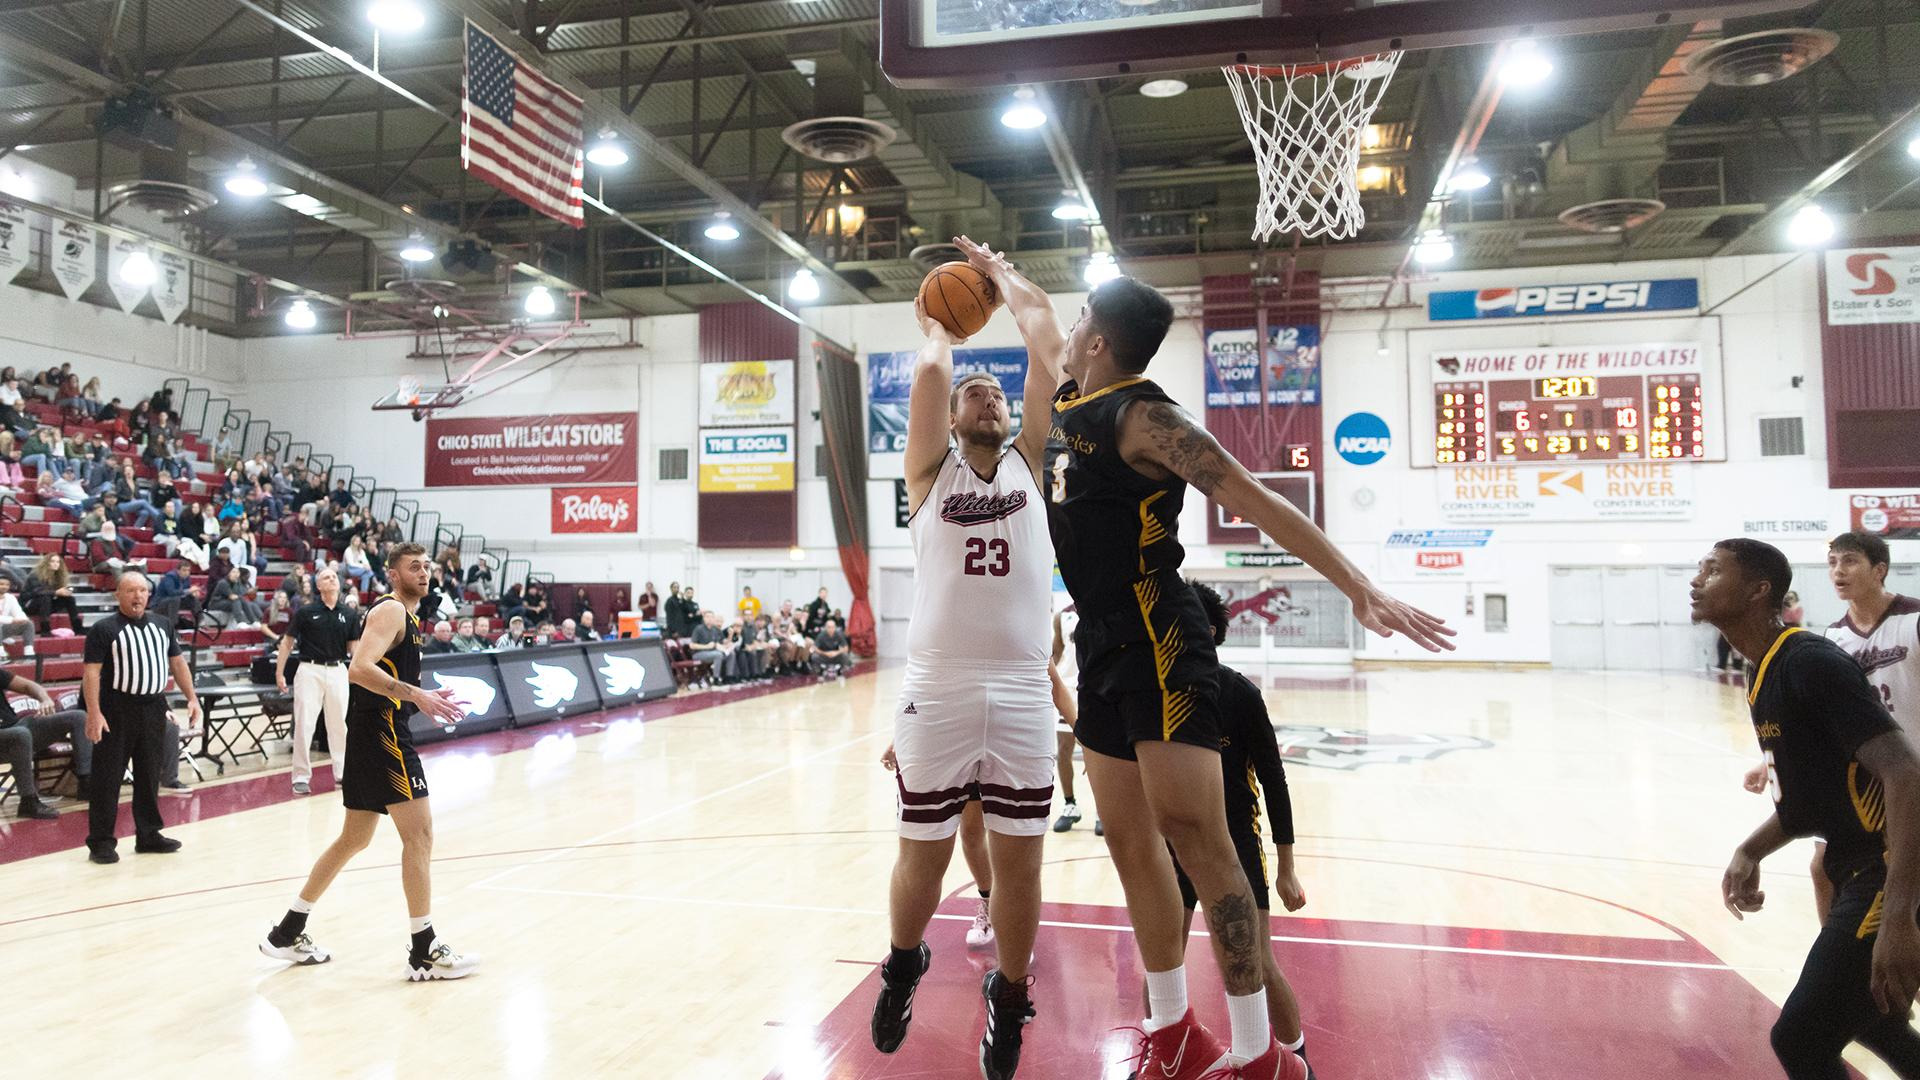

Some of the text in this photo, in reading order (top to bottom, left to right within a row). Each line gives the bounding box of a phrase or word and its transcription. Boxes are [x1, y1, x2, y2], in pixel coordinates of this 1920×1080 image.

[1515, 282, 1651, 313] PEPSI
[1887, 298, 1912, 307] Son
[1212, 341, 1262, 353] ACTIO
[989, 362, 1022, 374] News
[1465, 348, 1697, 373] HOME OF THE WILDCATS!
[1541, 377, 1596, 398] 12:07
[1515, 411, 1531, 431] 6
[1616, 408, 1638, 428] 10
[437, 423, 624, 451] CHICO STATE WILDCAT STORE
[708, 436, 785, 452] THE SOCIAL
[1339, 436, 1390, 454] NCAA
[1501, 438, 1516, 454] 5
[1524, 438, 1538, 453] 4
[1546, 436, 1571, 454] 23
[1595, 436, 1610, 452] 4
[1624, 435, 1638, 452] 3
[451, 452, 609, 467] Located in Bell Memorial Union or online at
[1291, 447, 1310, 467] 15
[472, 464, 586, 477] ChicoStateWildcatStore.com
[1454, 464, 1518, 482] KNIFE
[1605, 462, 1673, 479] KNIFE
[1456, 484, 1519, 500] RIVER
[1608, 481, 1675, 497] RIVER
[1441, 501, 1536, 510] CONSTRUCTION
[1593, 499, 1692, 508] CONSTRUCTION
[1852, 495, 1880, 508] GO
[561, 494, 629, 528] Raley's
[1744, 520, 1828, 533] BUTTE STRONG
[964, 537, 1010, 577] 23
[1227, 624, 1261, 636] HICO
[411, 776, 426, 790] LA
